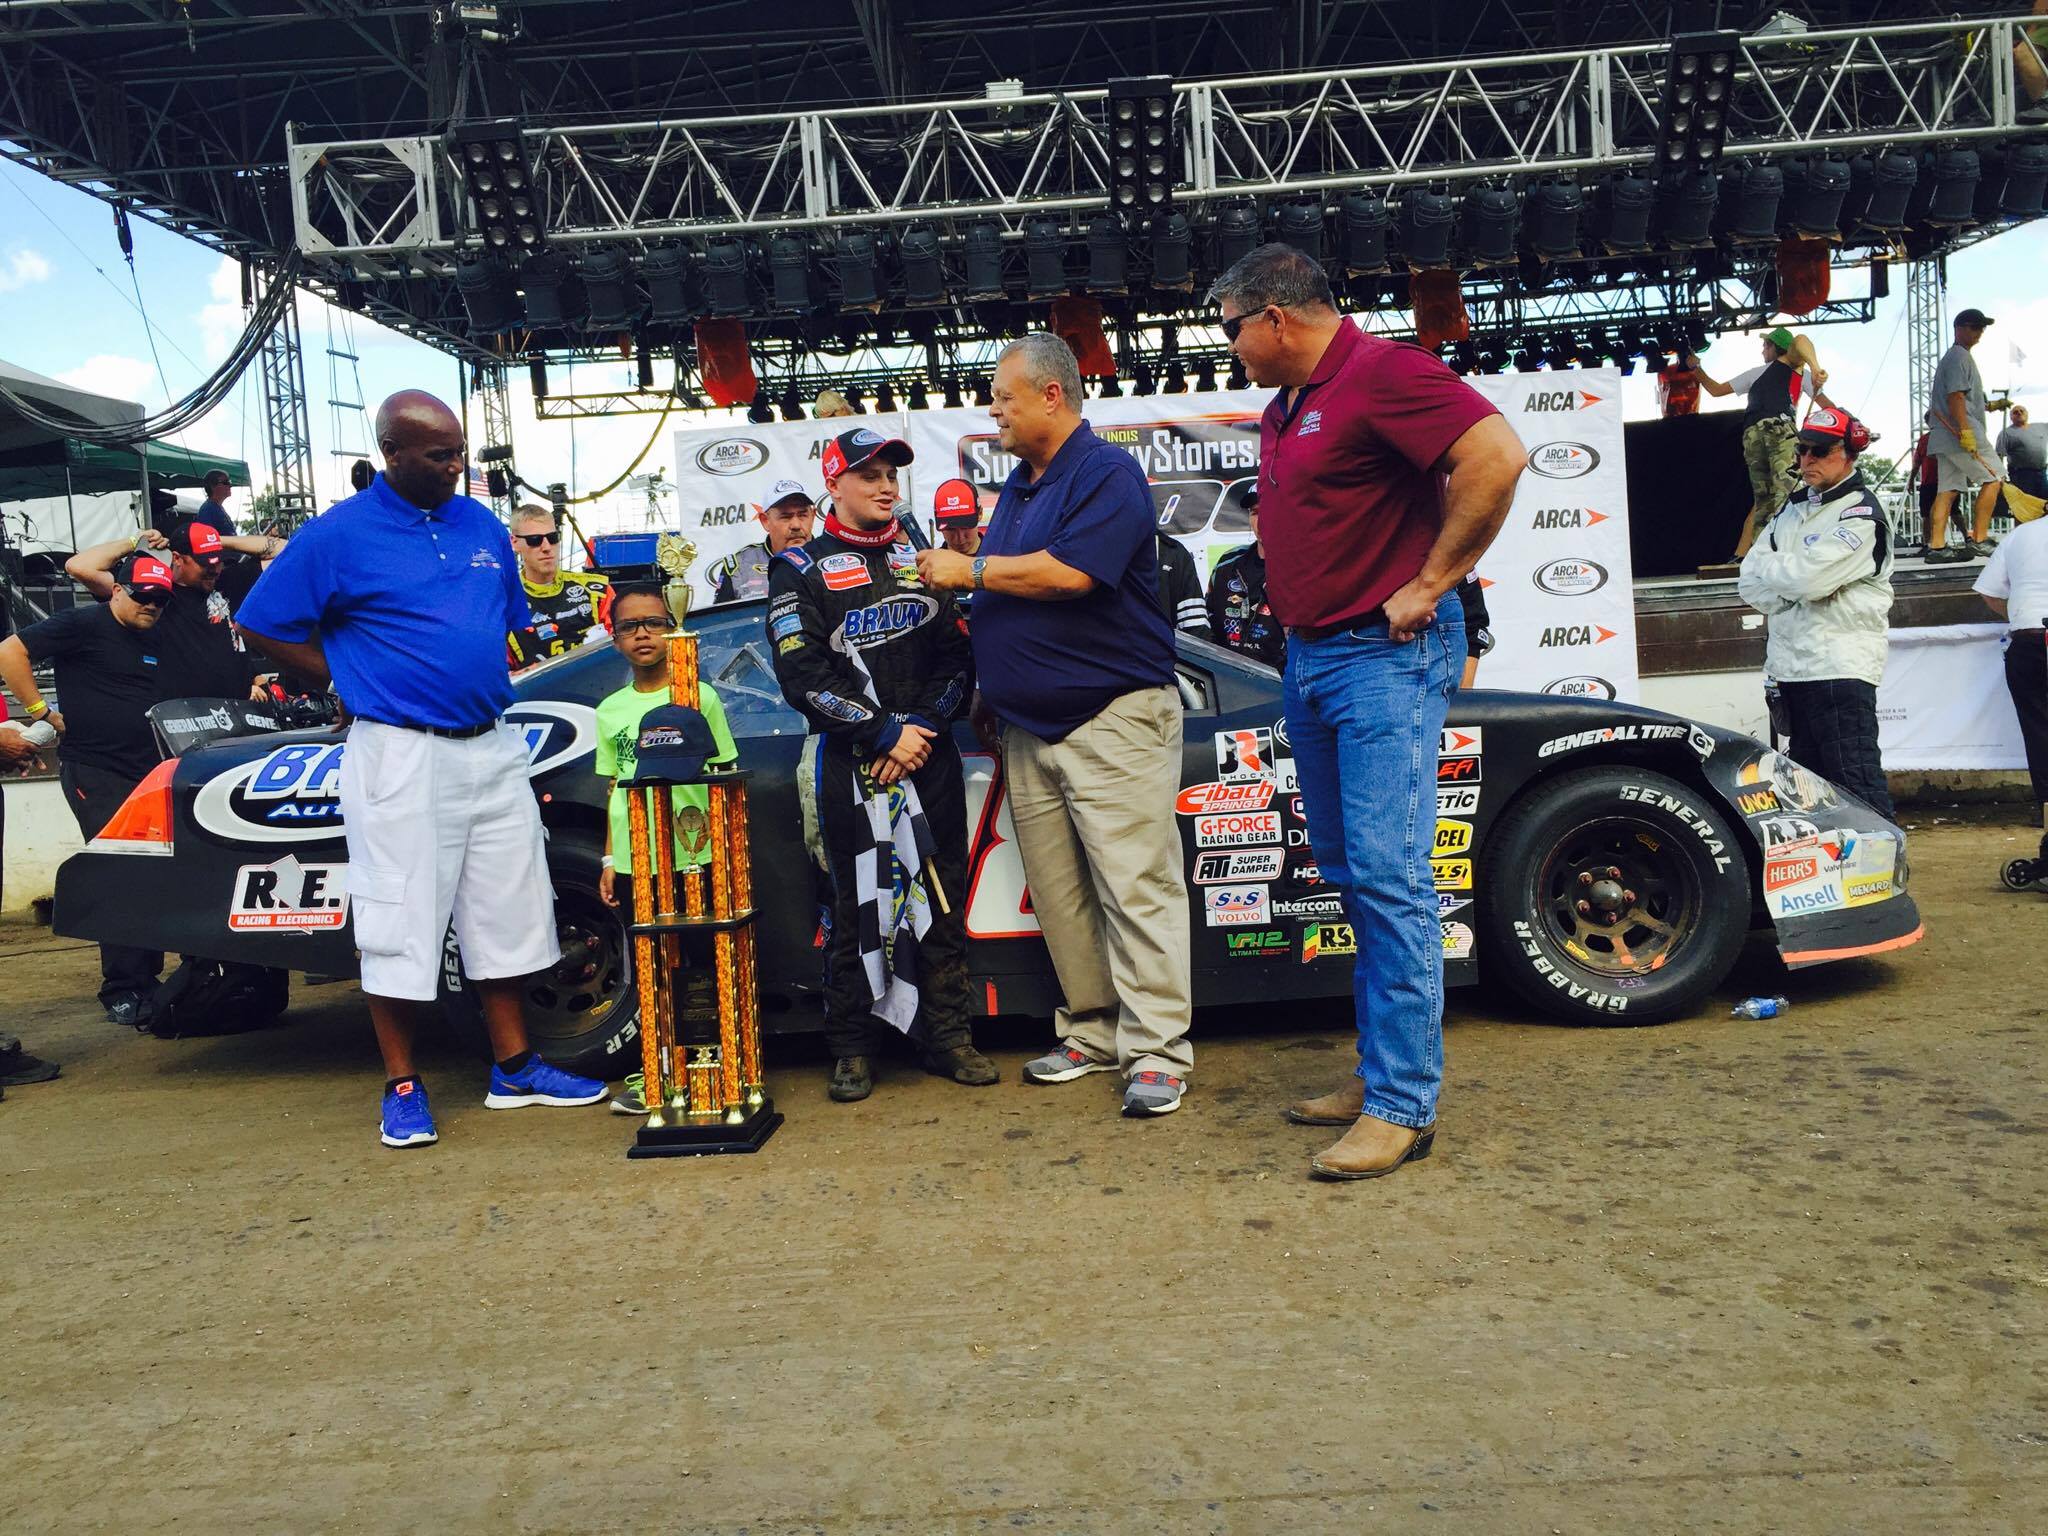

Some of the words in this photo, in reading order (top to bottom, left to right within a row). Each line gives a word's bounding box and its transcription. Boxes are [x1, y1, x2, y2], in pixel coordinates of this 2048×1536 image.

[1524, 391, 1574, 412] ARCA
[715, 445, 740, 457] ARCA
[1544, 449, 1569, 459] ARCA
[700, 504, 746, 527] ARCA
[1532, 509, 1582, 529] ARCA
[1552, 565, 1578, 577] ARCA
[844, 603, 924, 639] BRAUN
[1539, 626, 1591, 648] ARCA
[1560, 683, 1585, 696] ARCA
[162, 718, 198, 734] GENERAL
[197, 715, 218, 731] TIRE
[1538, 726, 1638, 758] GENERAL
[1640, 725, 1688, 740] TIRE
[1220, 771, 1276, 781] SHOCKS
[1176, 779, 1274, 813] Eibach
[1737, 791, 1779, 815] UNOH
[1200, 800, 1263, 812] SPRINGS
[1200, 815, 1276, 835] G-FORCE
[1618, 784, 1732, 875] GENERAL
[1202, 833, 1243, 845] RACING
[1251, 831, 1276, 842] GEAR
[1231, 863, 1277, 875] DAMPER
[1236, 855, 1271, 865] SUPER
[1769, 860, 1814, 884] HERR'S
[1781, 884, 1839, 913] Ansell
[237, 916, 271, 926] RACING
[276, 914, 335, 925] ELECTRONICS
[1217, 912, 1260, 923] VOLVO
